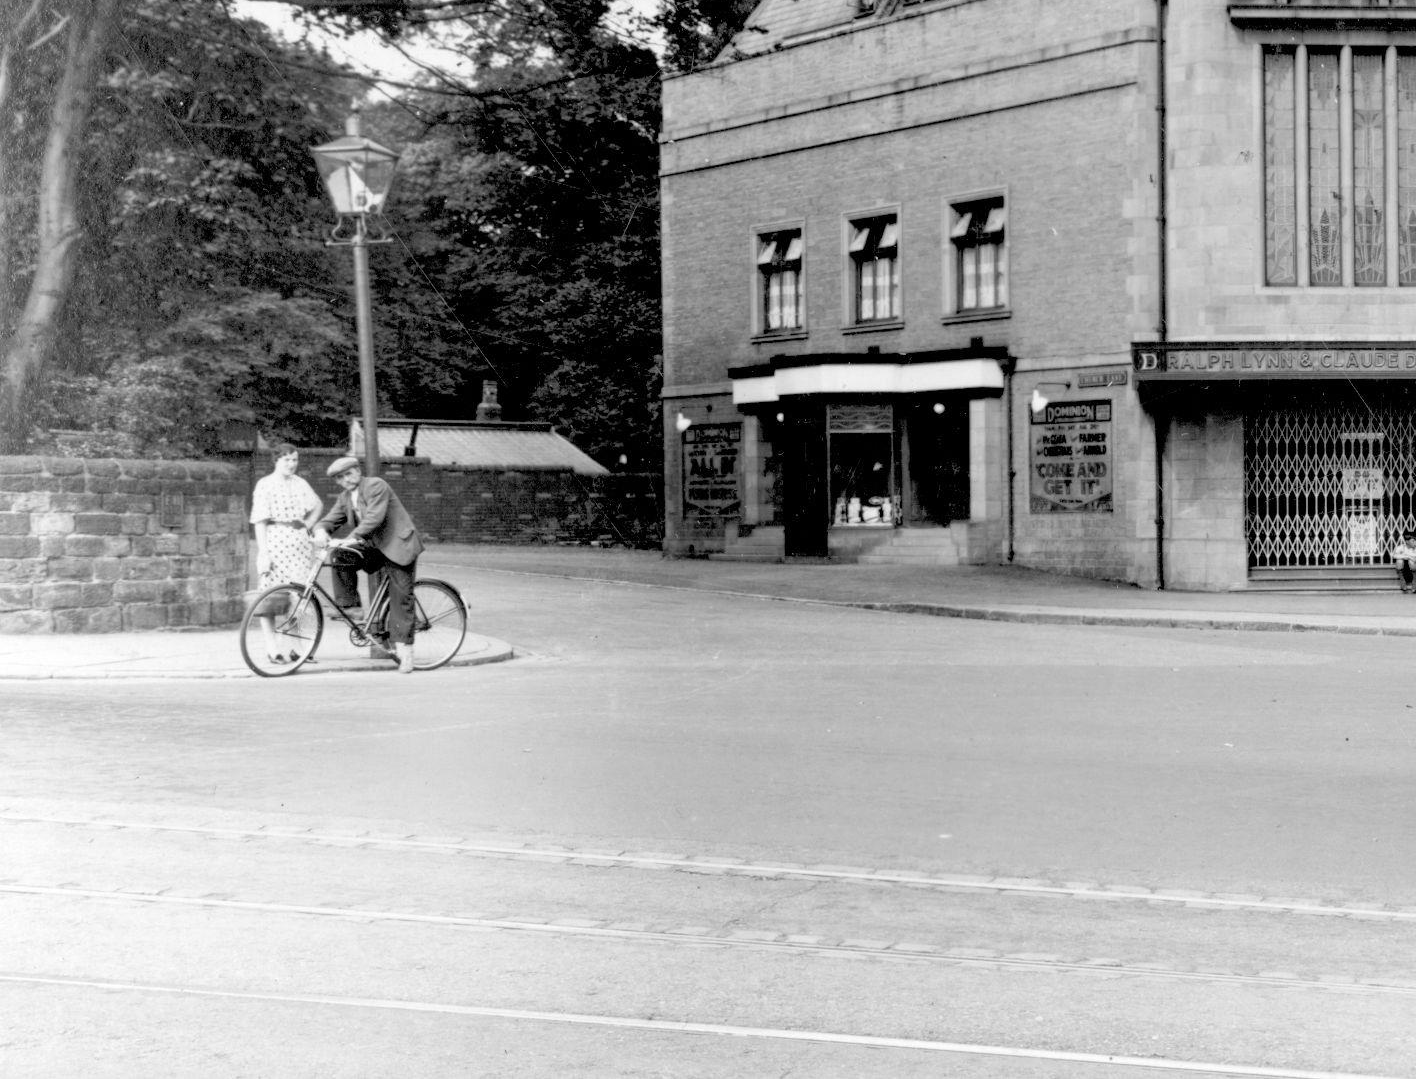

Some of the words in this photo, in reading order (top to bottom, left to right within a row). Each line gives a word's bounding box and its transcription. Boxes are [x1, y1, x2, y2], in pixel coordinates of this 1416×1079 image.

[1140, 352, 1157, 370] D
[1167, 351, 1234, 370] RALPH
[1241, 351, 1293, 370] LYNN
[1300, 351, 1313, 369] &
[1320, 352, 1399, 370] CLAUDE
[1047, 405, 1095, 422] DOMINION
[1044, 480, 1072, 495] GET
